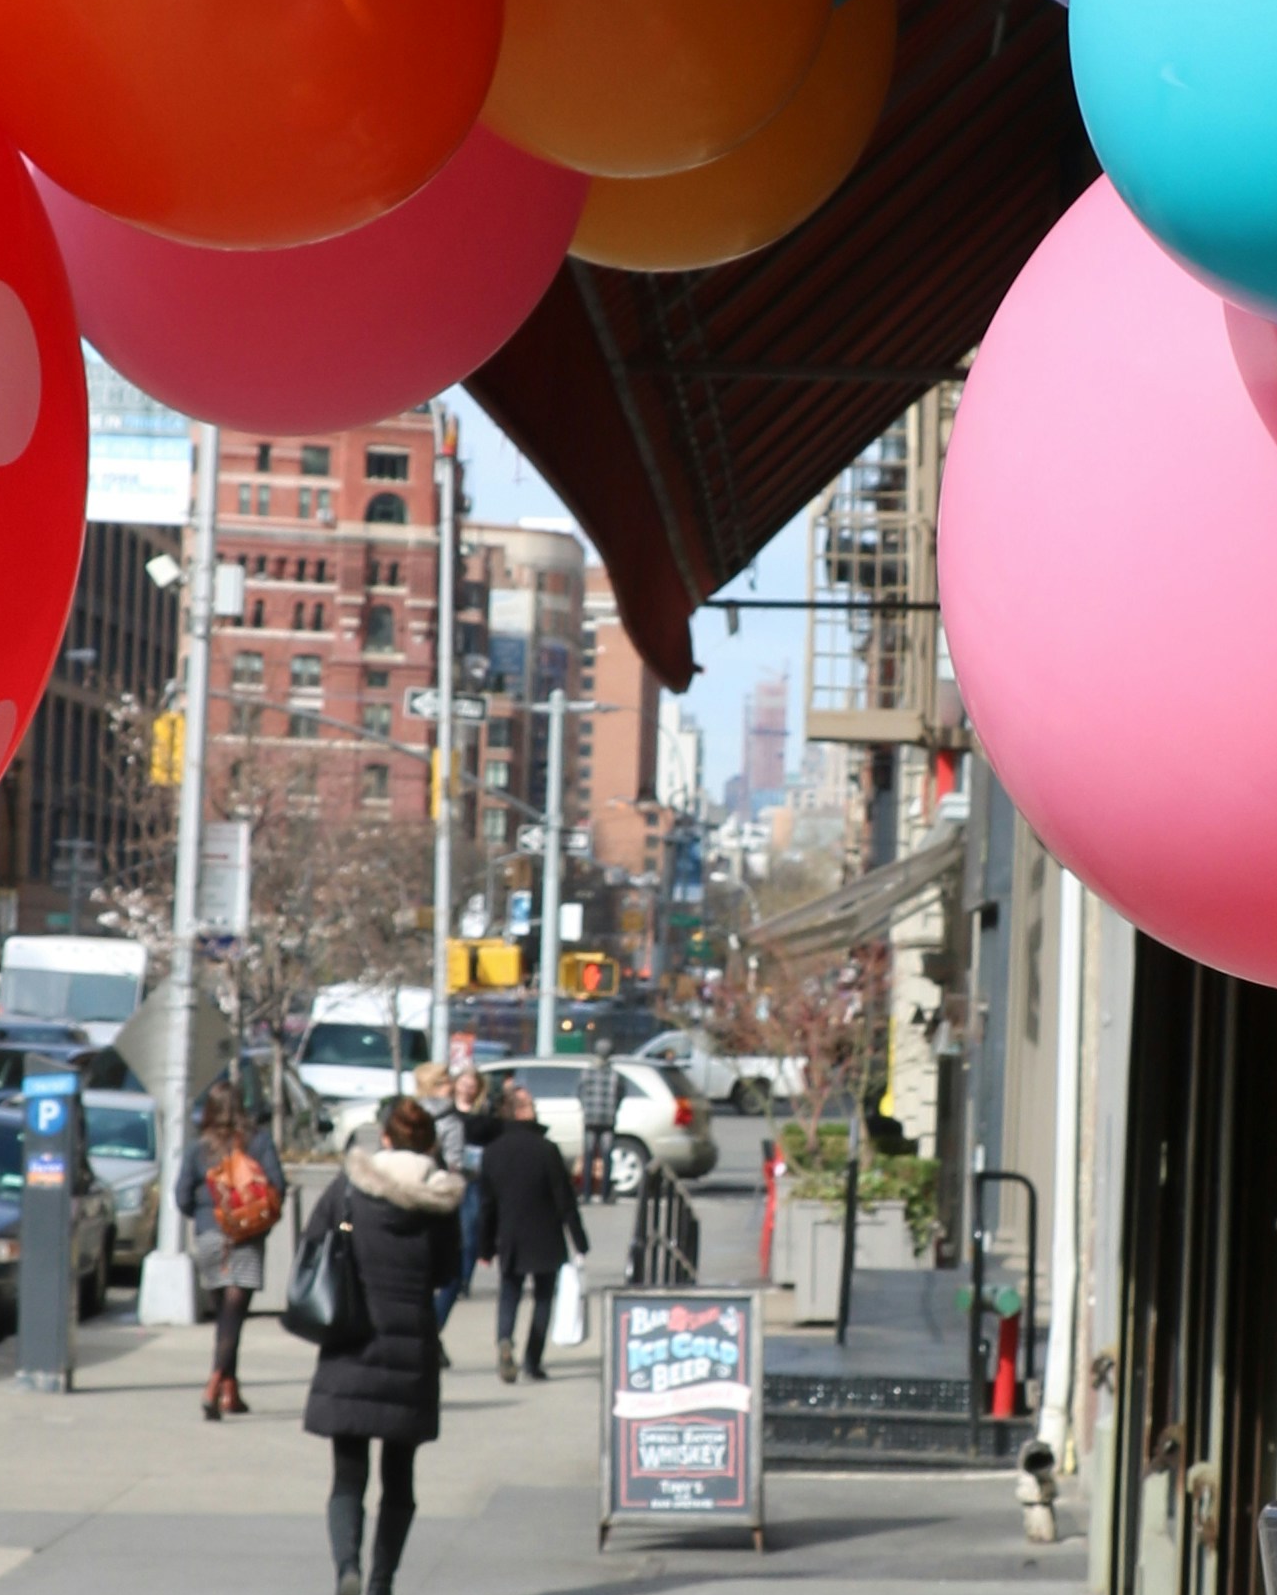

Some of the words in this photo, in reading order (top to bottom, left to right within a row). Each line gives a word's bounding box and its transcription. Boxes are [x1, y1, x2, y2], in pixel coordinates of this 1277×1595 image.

[38, 1099, 61, 1132] P
[652, 1357, 712, 1392] BEER
[638, 1444, 727, 1469] WHISKEY
